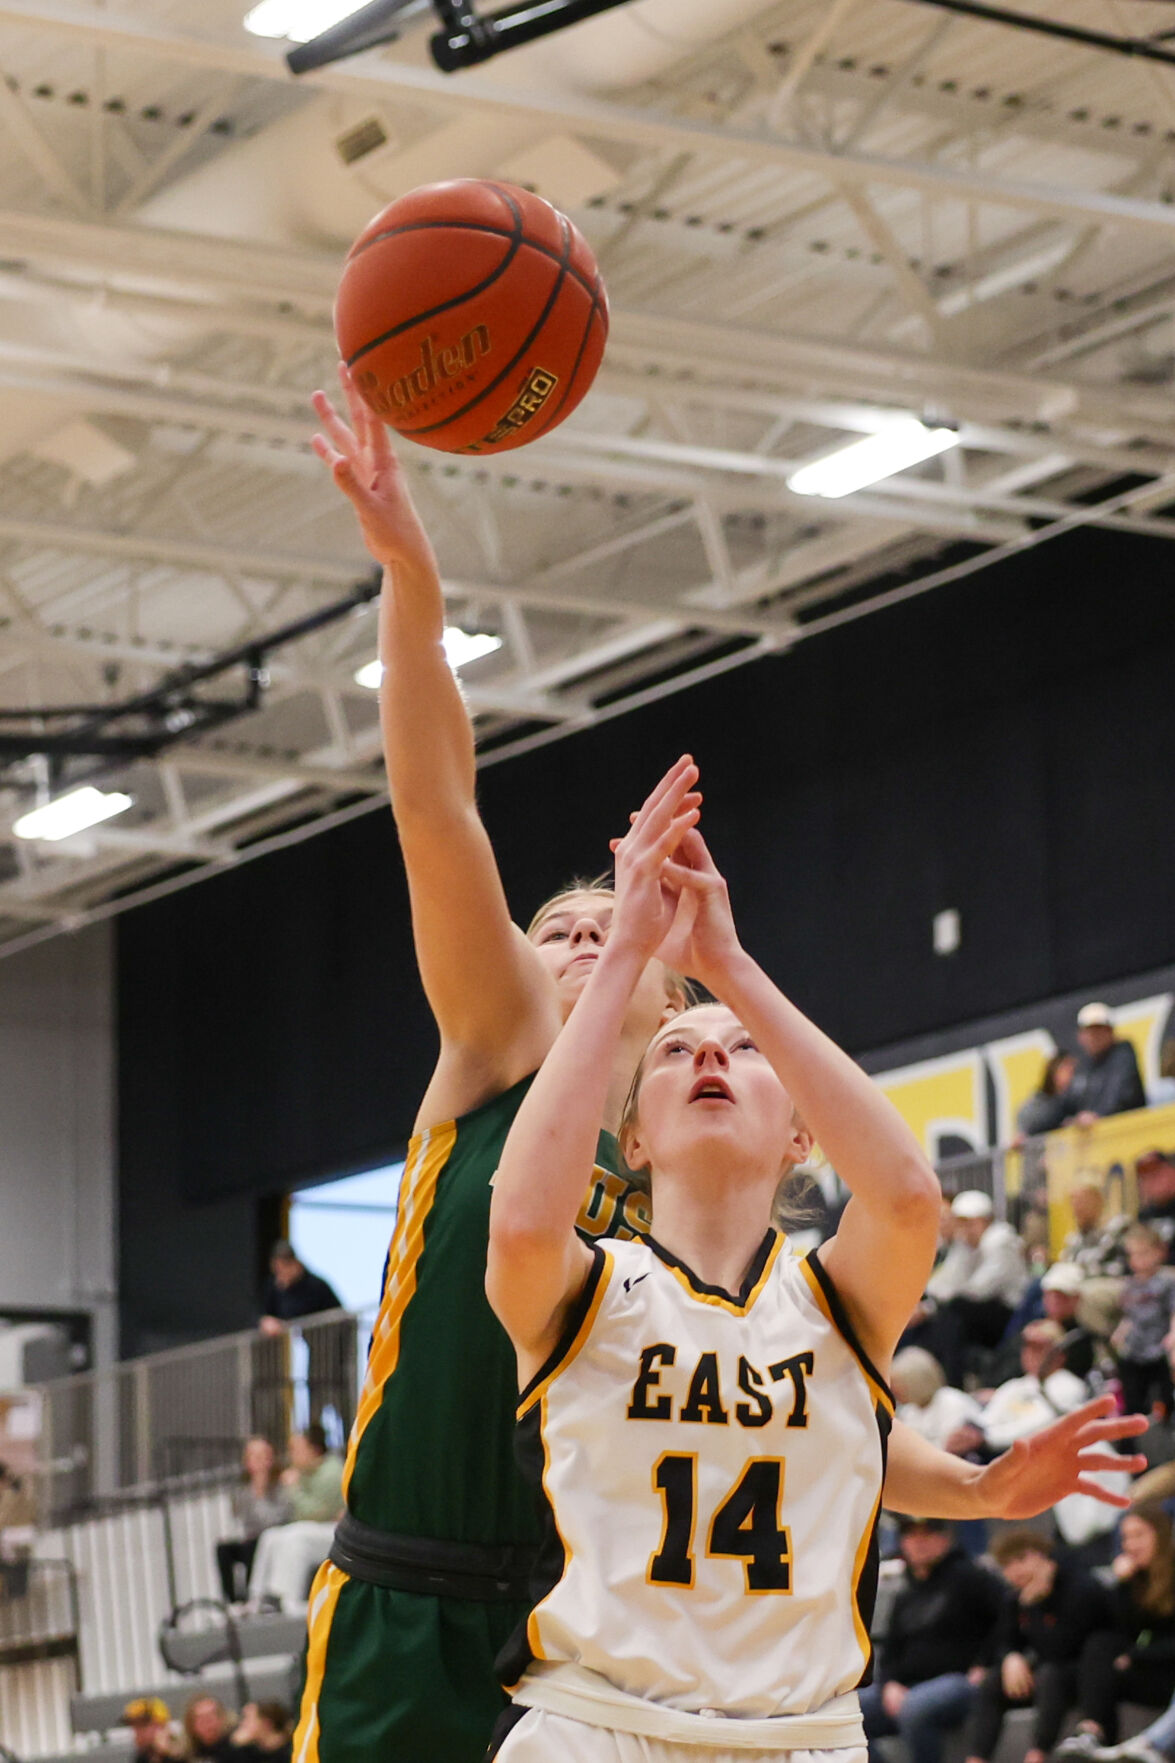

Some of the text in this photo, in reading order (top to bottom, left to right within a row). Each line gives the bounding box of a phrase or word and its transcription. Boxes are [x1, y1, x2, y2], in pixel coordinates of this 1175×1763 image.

[506, 374, 553, 426] PRO
[626, 1342, 816, 1430] EAST
[645, 1449, 794, 1596] 14
